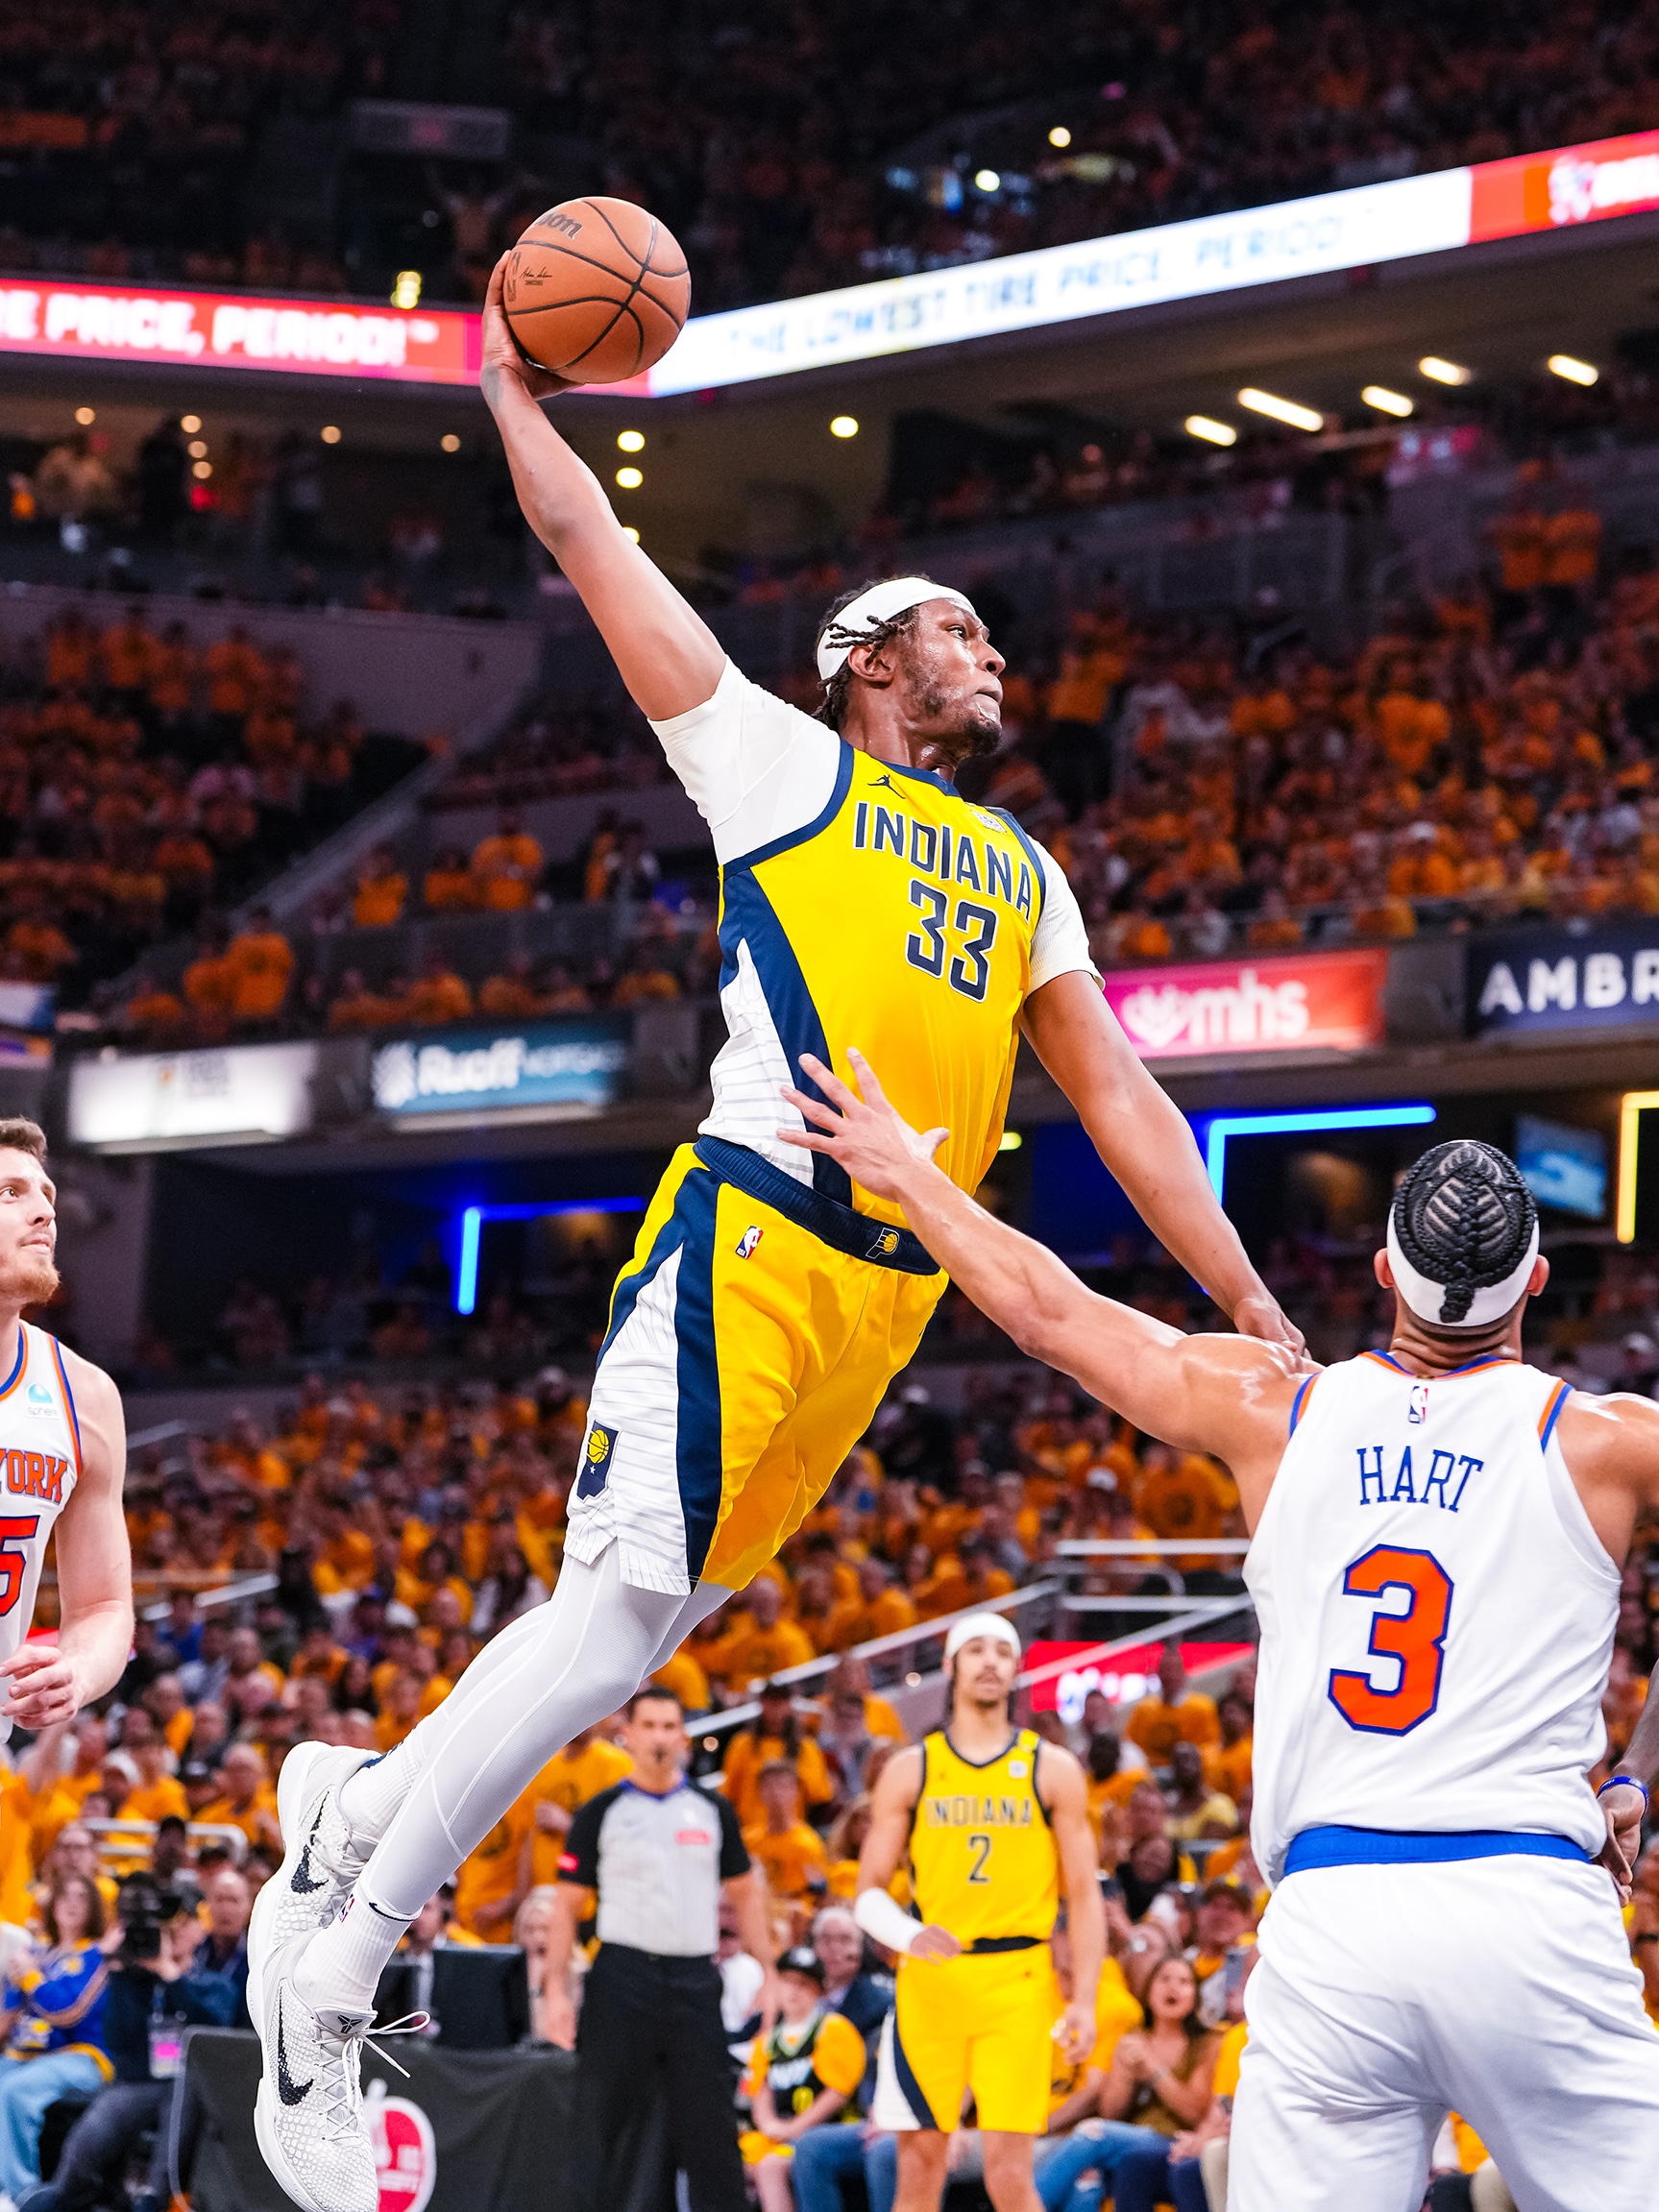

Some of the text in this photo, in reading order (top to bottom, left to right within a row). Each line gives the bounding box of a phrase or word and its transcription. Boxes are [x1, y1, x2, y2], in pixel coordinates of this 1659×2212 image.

[804, 288, 947, 349] LOWEST
[964, 268, 1040, 316] TIRE
[853, 801, 1032, 924] INDIANA
[905, 878, 997, 1004] 33
[1187, 967, 1309, 1044] mhs
[1356, 1446, 1484, 1513] HART
[0, 1515, 40, 1616] 5
[1328, 1544, 1454, 1737] 3
[925, 1795, 1032, 1829] INDIANA
[967, 1833, 992, 1884] 2
